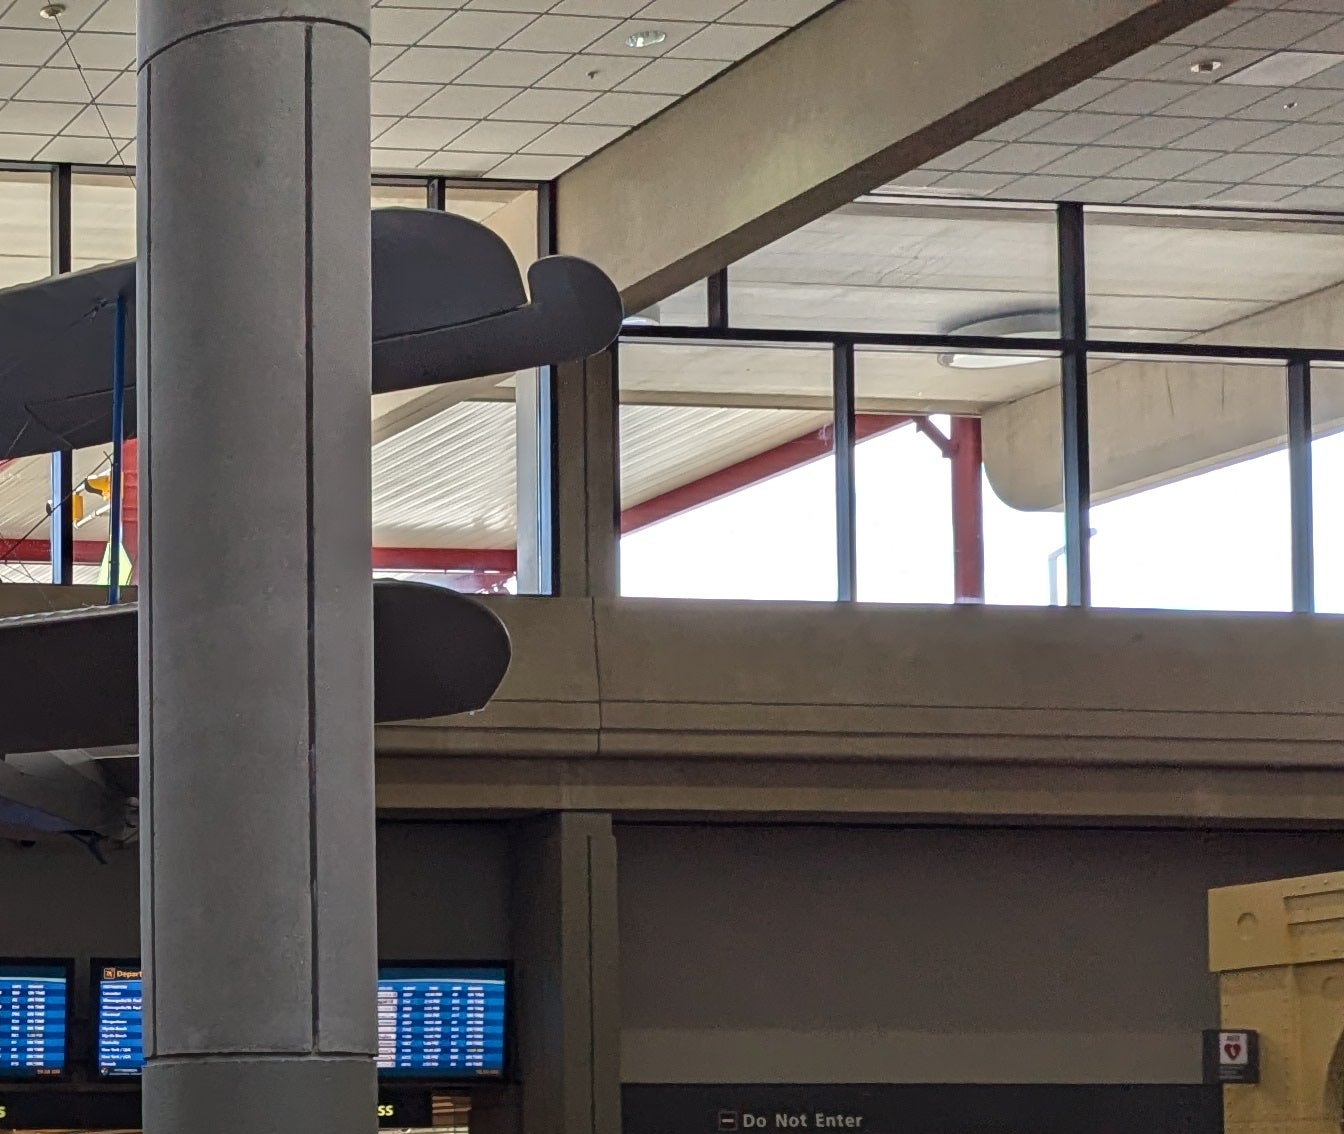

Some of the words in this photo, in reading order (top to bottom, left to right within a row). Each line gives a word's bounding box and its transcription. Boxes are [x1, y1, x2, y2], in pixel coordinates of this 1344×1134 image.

[116, 970, 143, 979] Depart
[378, 1105, 394, 1116] ss
[742, 1113, 767, 1128] Do
[775, 1113, 807, 1128] Not
[815, 1112, 863, 1128] Enter
